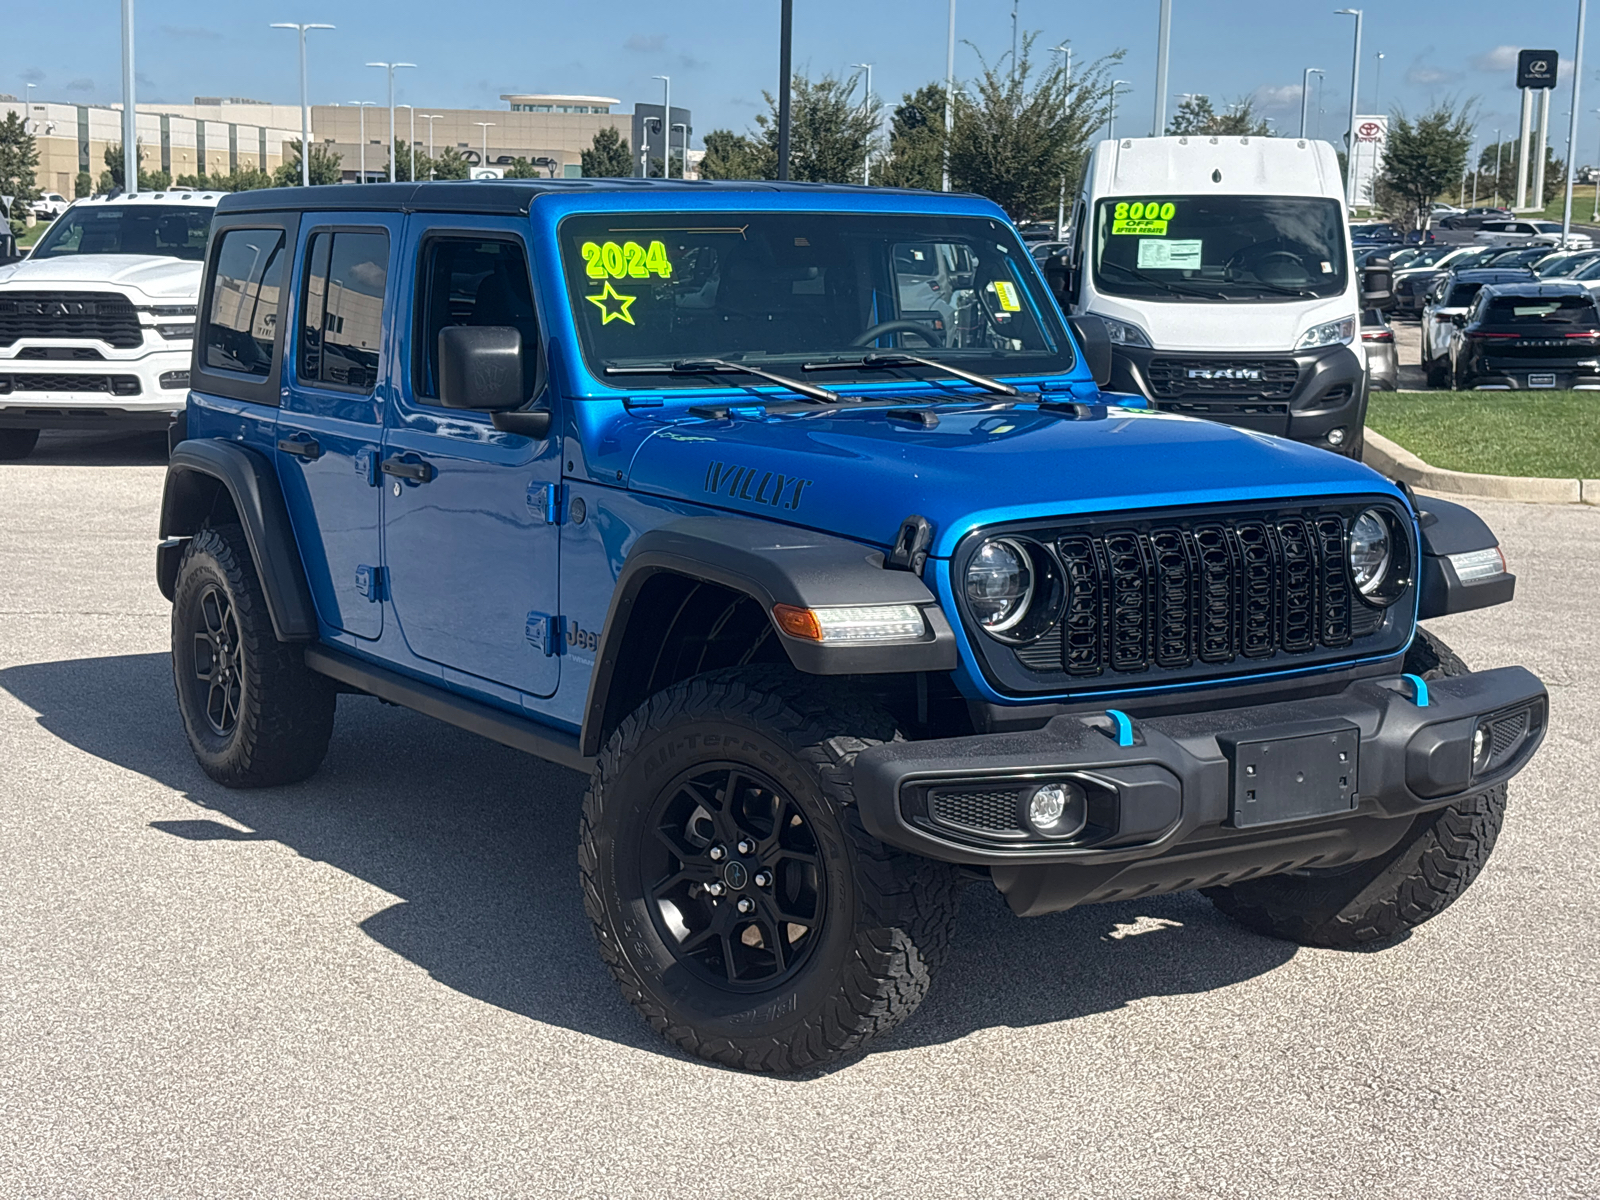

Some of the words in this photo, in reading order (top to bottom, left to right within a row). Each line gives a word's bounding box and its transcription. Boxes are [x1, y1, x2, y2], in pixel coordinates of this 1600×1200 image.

[485, 155, 549, 166] LEUS
[1114, 202, 1175, 220] 8000
[581, 240, 673, 279] 2024
[18, 301, 97, 315] RAM
[1188, 368, 1259, 379] RAM
[703, 460, 814, 511] WILLYS
